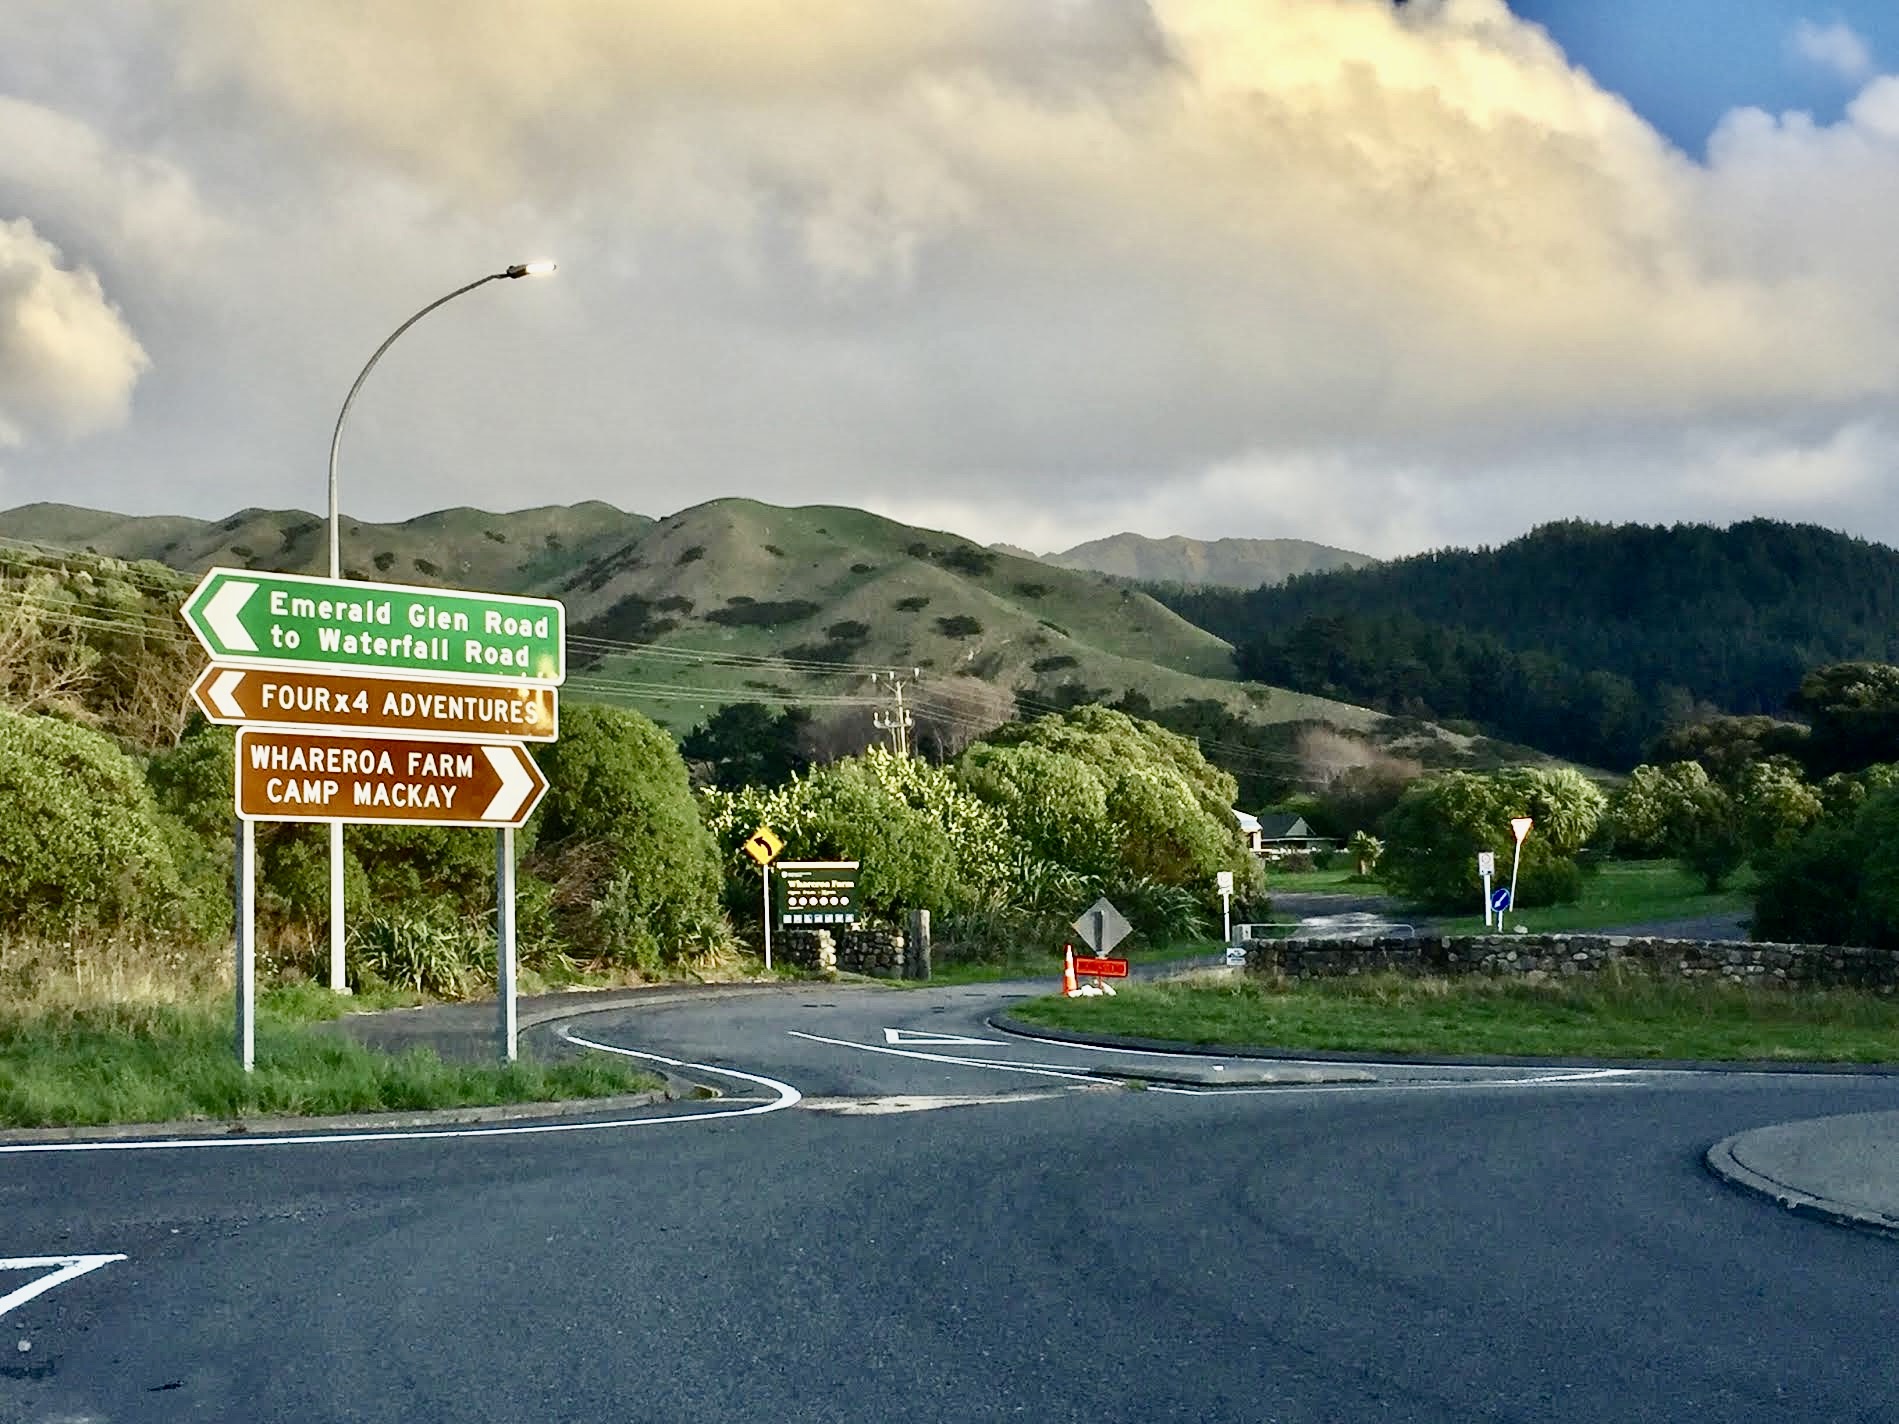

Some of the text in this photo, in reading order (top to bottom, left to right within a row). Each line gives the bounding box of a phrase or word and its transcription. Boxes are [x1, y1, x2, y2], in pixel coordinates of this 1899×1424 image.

[270, 592, 548, 639] Emerald Glen Road
[271, 624, 529, 667] to Waterfall Road
[263, 684, 538, 724] FOURx4 ADVENTURES
[251, 745, 473, 778] WHAREROA FARM
[267, 779, 457, 808] CAMP MACKAY
